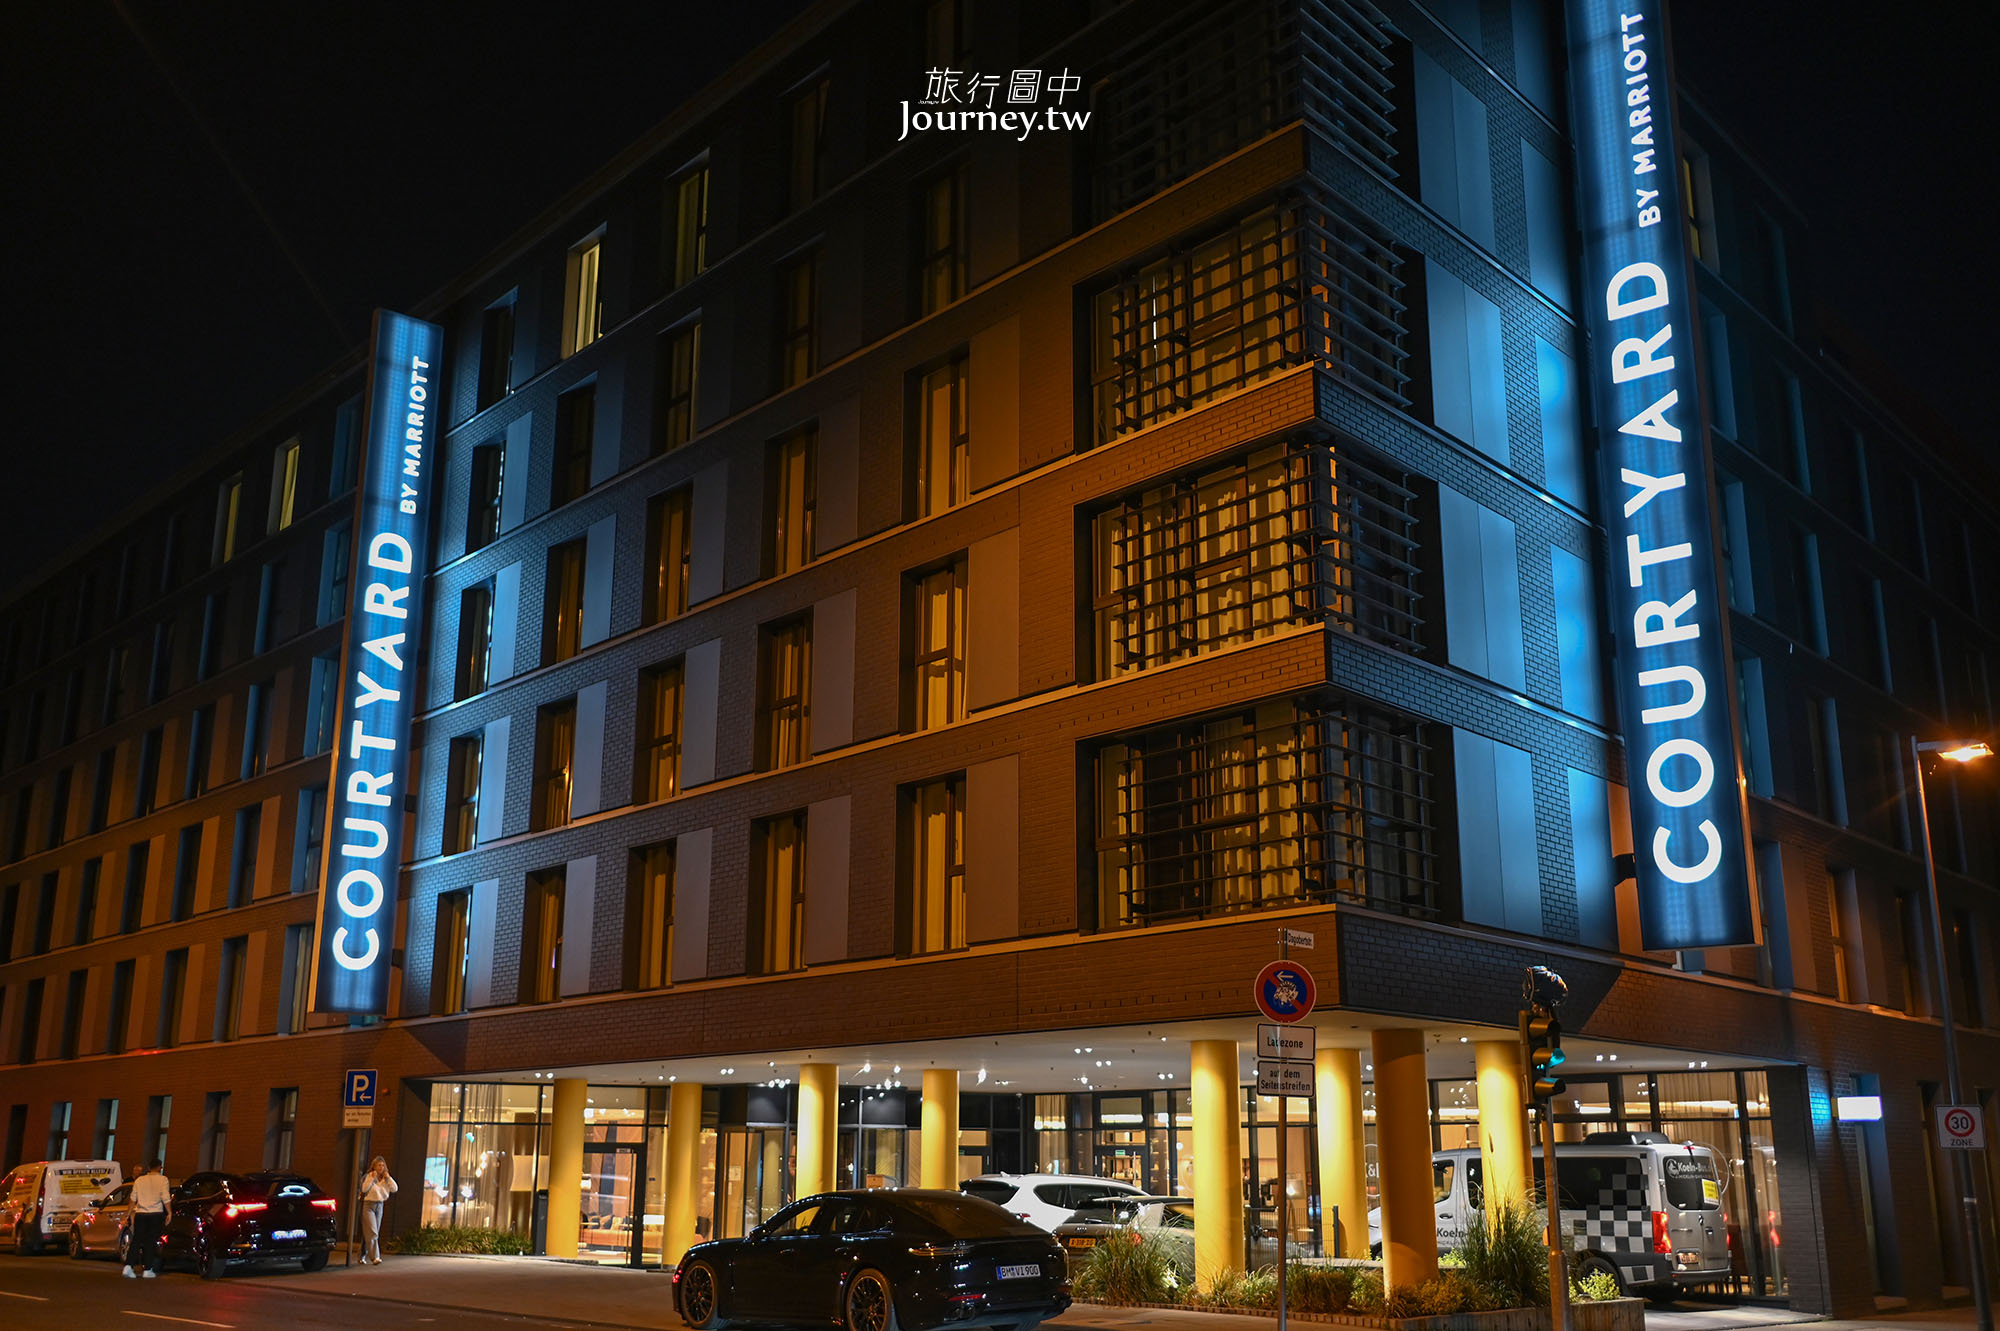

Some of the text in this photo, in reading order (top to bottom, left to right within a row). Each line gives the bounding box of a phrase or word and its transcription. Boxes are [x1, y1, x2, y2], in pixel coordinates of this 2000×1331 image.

[1620, 13, 1661, 228] BY MARRIOTT
[400, 355, 429, 515] BY MARRIOTT
[1606, 262, 1722, 884] COURTYARD
[332, 532, 413, 971] COURTYARD
[351, 1074, 370, 1103] P
[1283, 1069, 1301, 1079] dem
[1950, 1115, 1970, 1130] 30
[1950, 1138, 1974, 1147] ZONE
